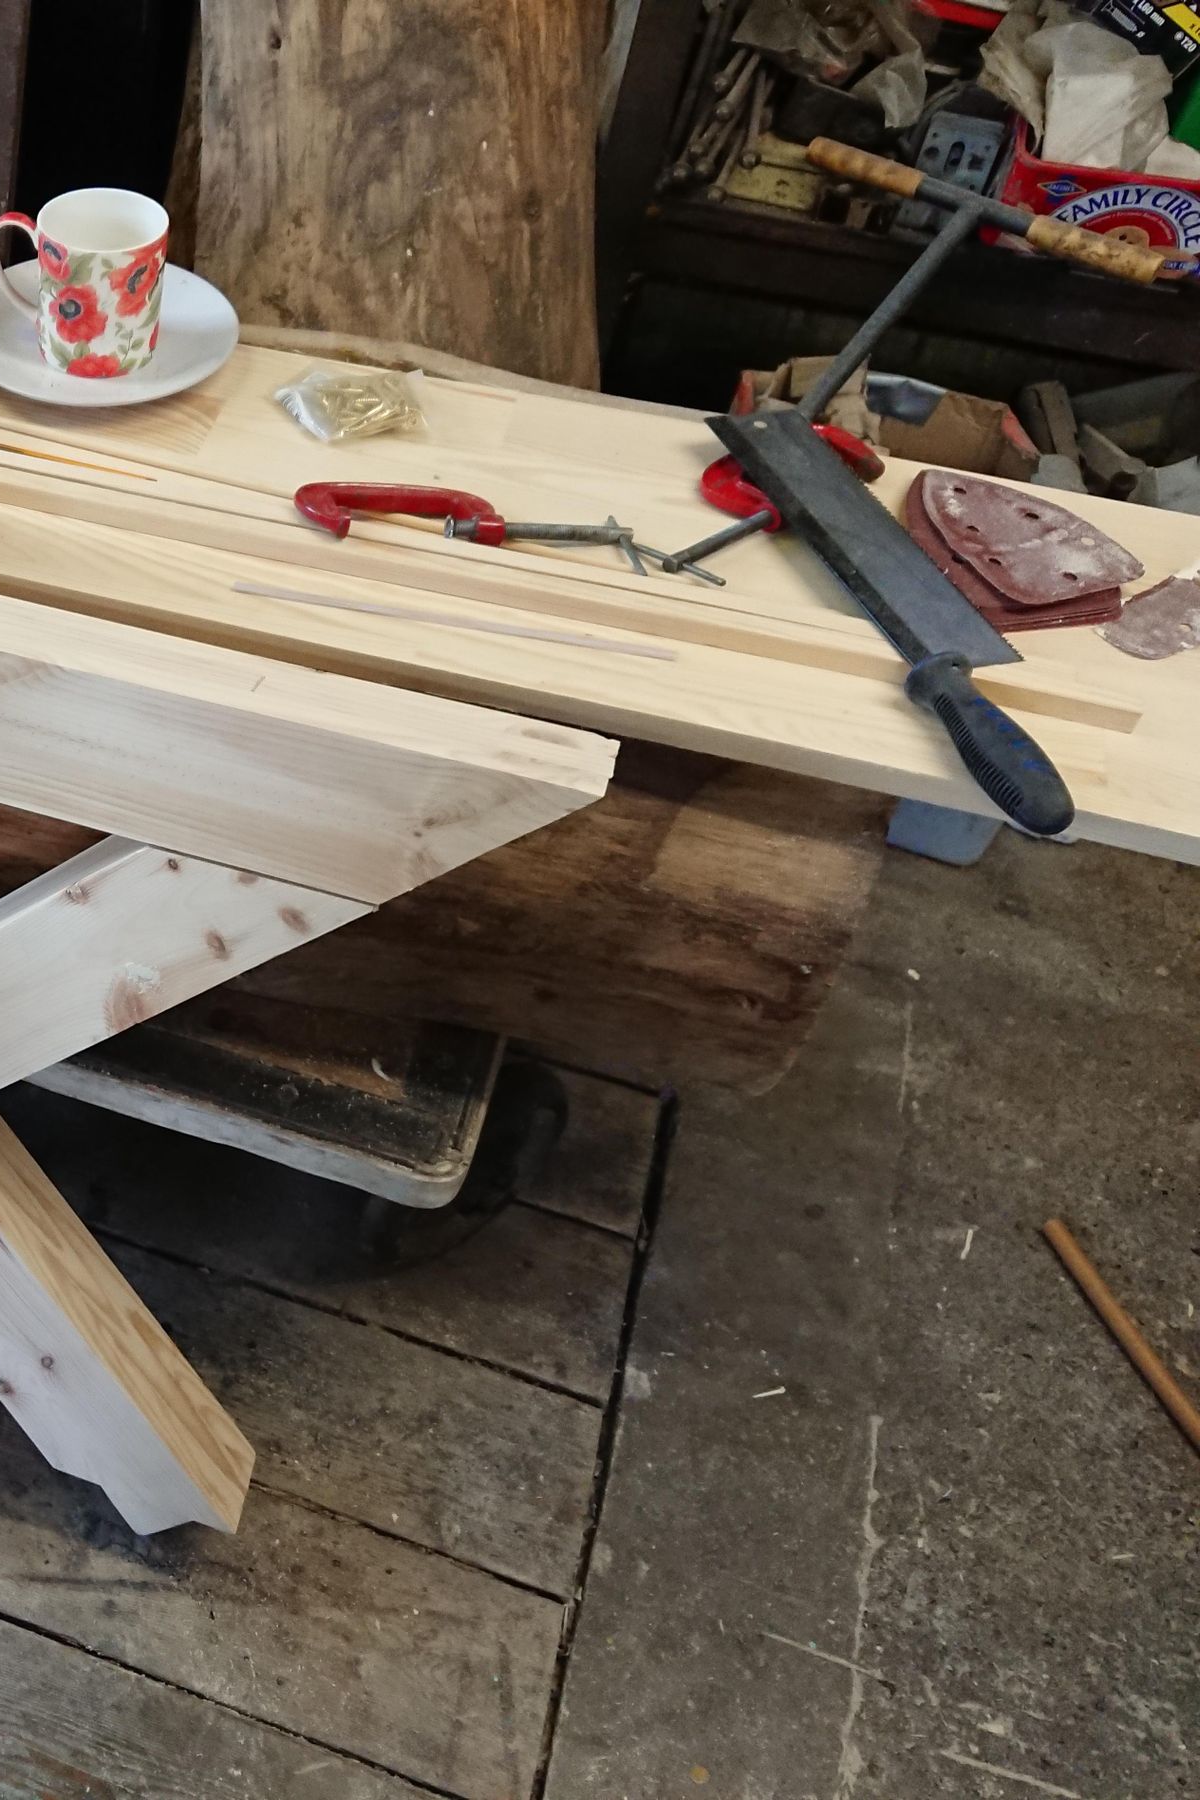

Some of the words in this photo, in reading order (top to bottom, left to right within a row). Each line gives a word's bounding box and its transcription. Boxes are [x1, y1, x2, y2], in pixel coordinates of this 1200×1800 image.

[1181, 36, 1197, 52] T20
[1056, 188, 1151, 222] FAMILY
[1151, 191, 1200, 248] CIRCLE
